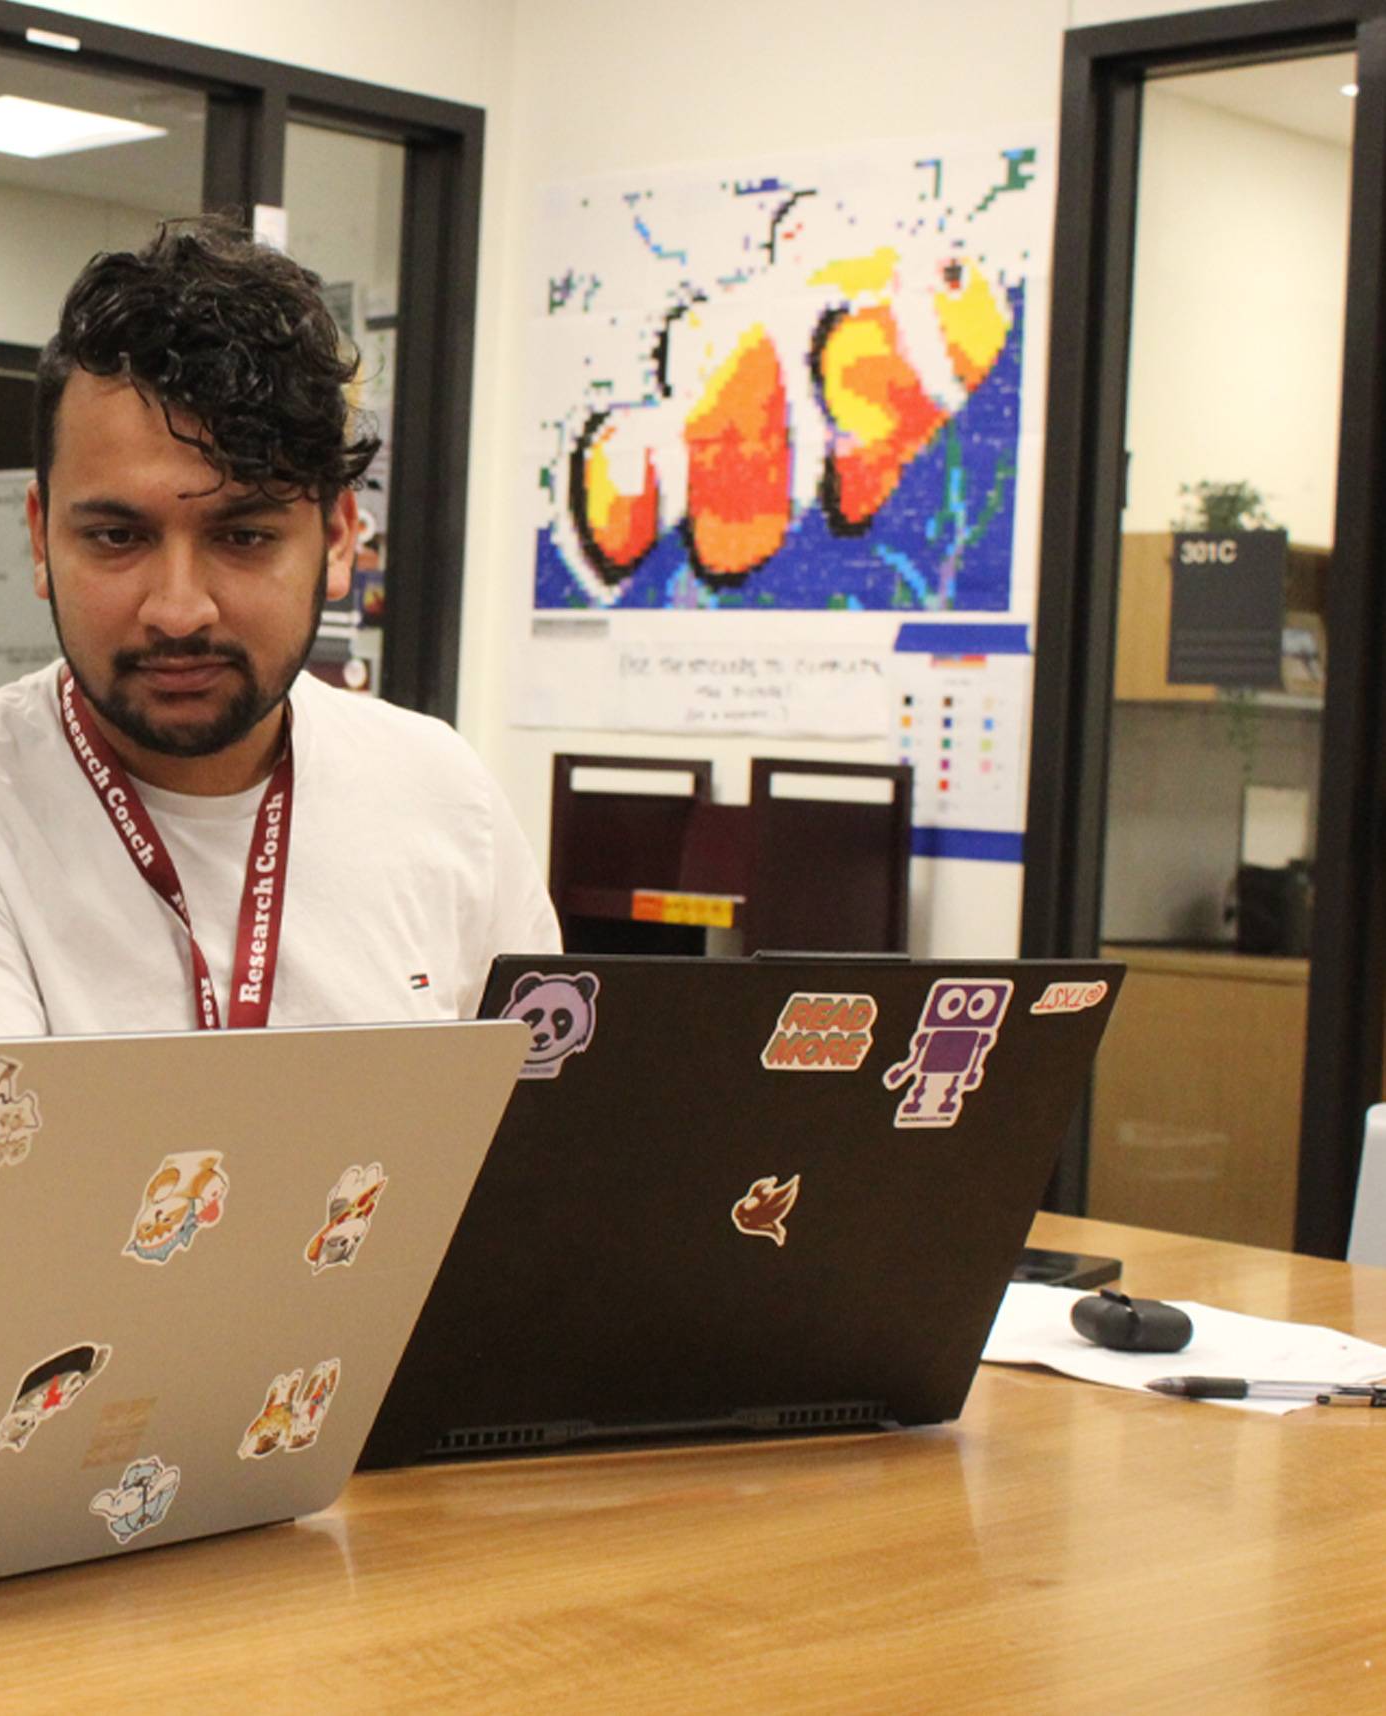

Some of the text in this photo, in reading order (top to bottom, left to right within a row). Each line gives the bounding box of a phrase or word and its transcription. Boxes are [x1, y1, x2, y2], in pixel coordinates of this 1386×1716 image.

[1180, 540, 1238, 564] 301C
[106, 787, 156, 869] Coach
[238, 791, 285, 1005] Research Coach
[780, 996, 872, 1031] READ
[1034, 986, 1087, 1010] TXST
[765, 1031, 869, 1066] MORE
